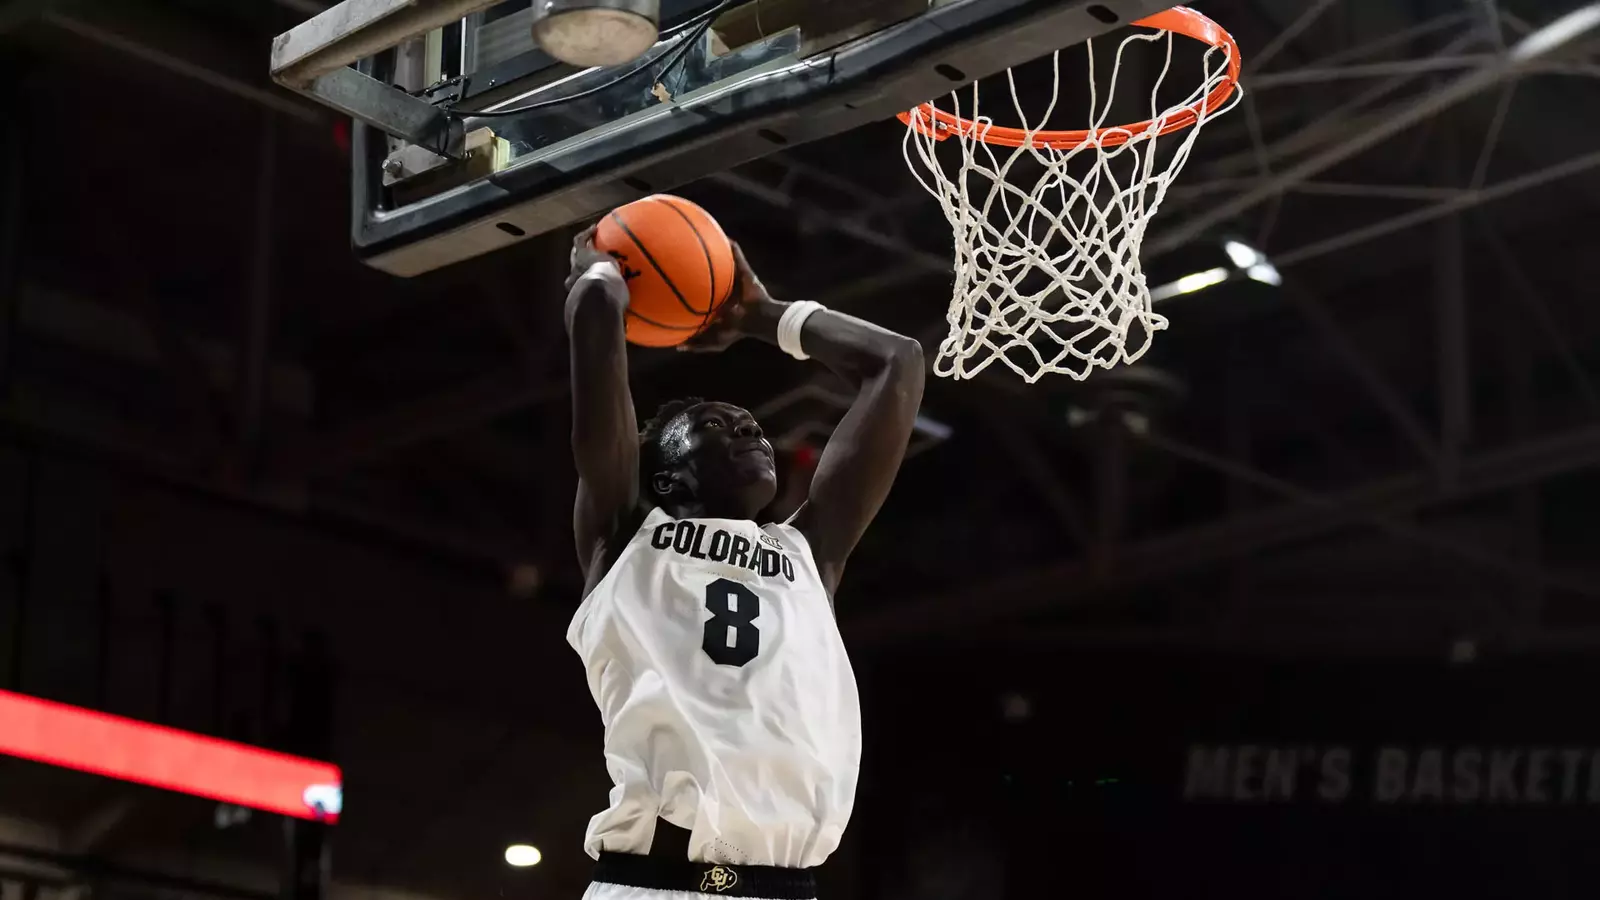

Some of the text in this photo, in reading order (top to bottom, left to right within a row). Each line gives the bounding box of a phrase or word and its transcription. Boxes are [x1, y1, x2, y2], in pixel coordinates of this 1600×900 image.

[651, 520, 795, 582] COLORADO
[702, 578, 760, 667] 8
[1184, 744, 1352, 801] MEN'S
[711, 867, 728, 886] CU
